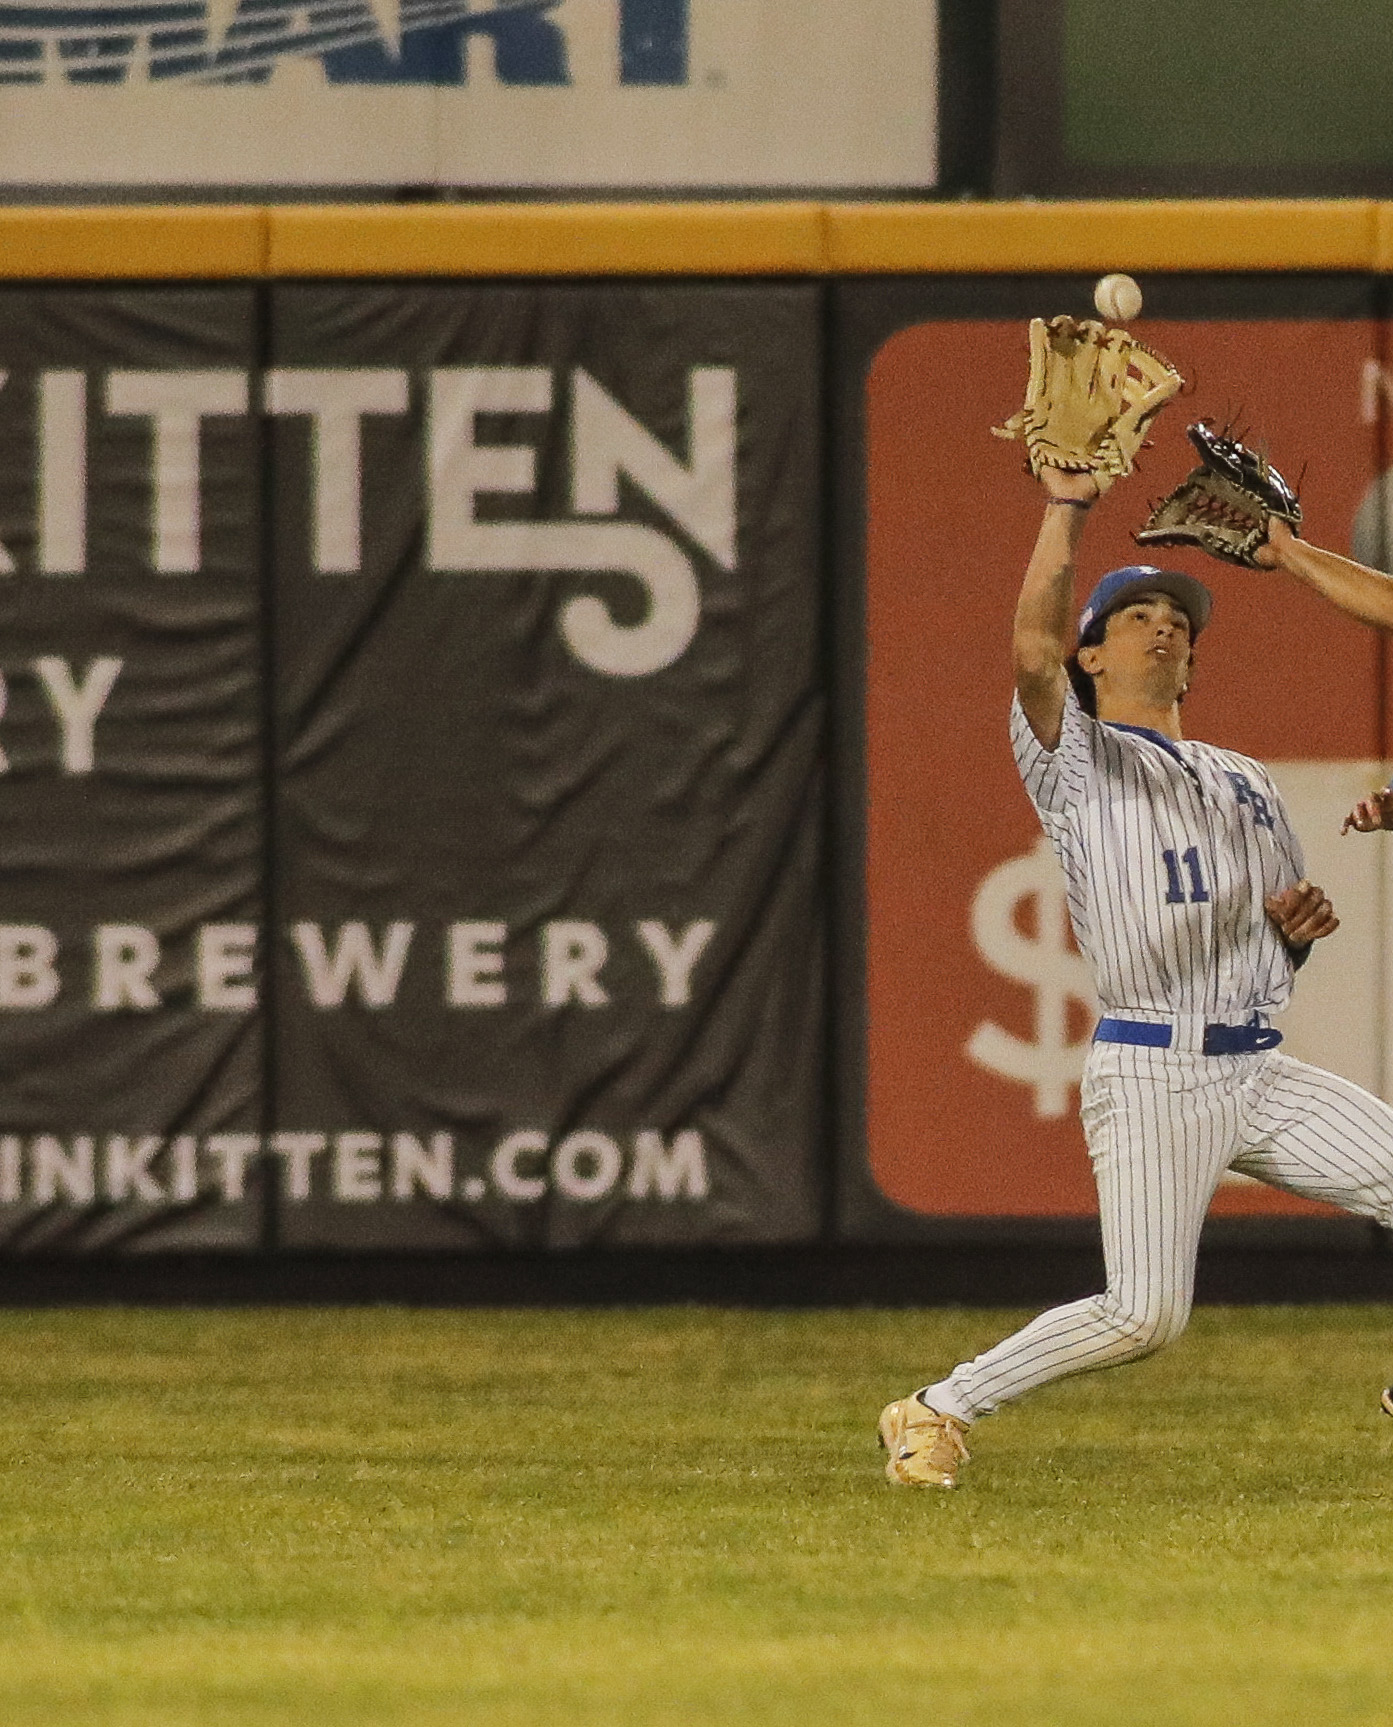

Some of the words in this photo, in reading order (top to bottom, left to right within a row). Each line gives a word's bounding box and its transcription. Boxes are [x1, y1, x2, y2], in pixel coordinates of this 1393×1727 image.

[0, 365, 739, 678] ITTEN
[1162, 845, 1210, 904] 11
[0, 920, 717, 1011] BREWERY
